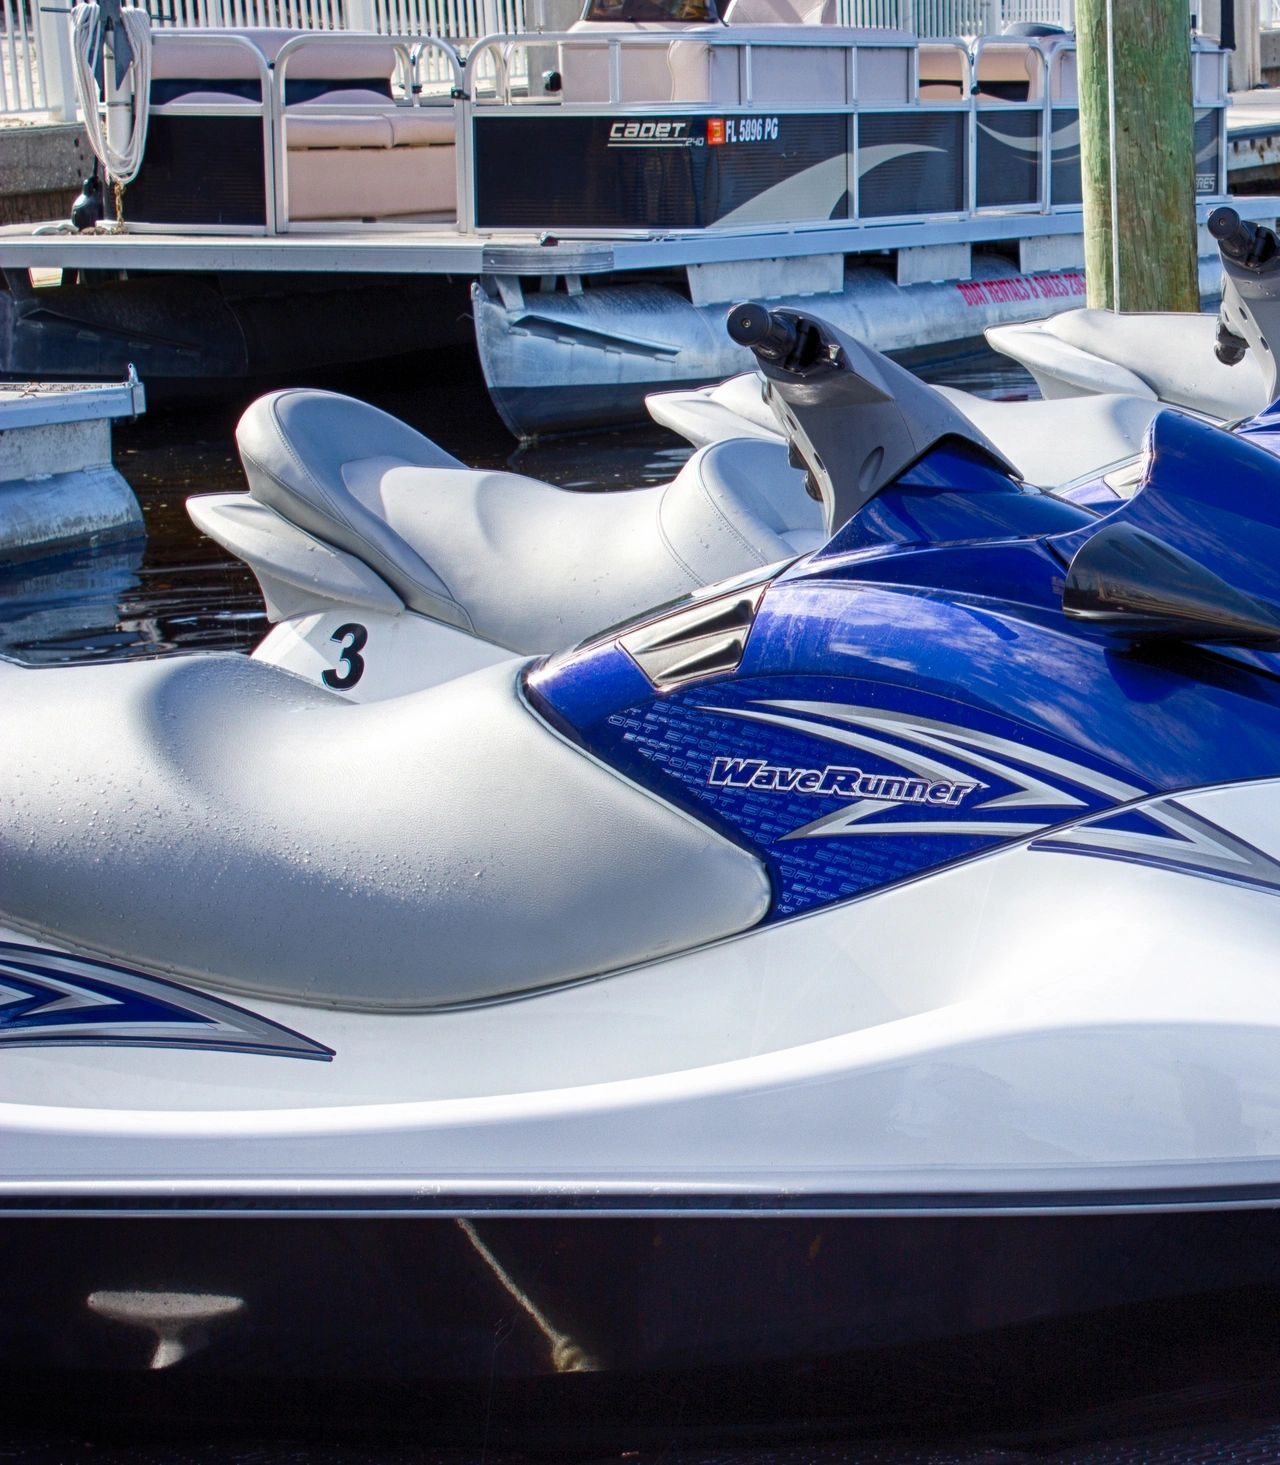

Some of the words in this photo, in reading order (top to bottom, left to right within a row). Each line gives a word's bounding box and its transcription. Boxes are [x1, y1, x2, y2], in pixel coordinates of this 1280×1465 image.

[685, 137, 705, 147] 240
[725, 120, 737, 143] FL
[739, 118, 763, 142] 5896
[764, 117, 779, 140] PG
[955, 282, 989, 307] BOAT
[983, 278, 1031, 304] RENTALS
[1033, 274, 1070, 299] SALES
[321, 622, 369, 691] 3
[622, 732, 682, 753] SPORT
[708, 756, 979, 808] WaveRunner
